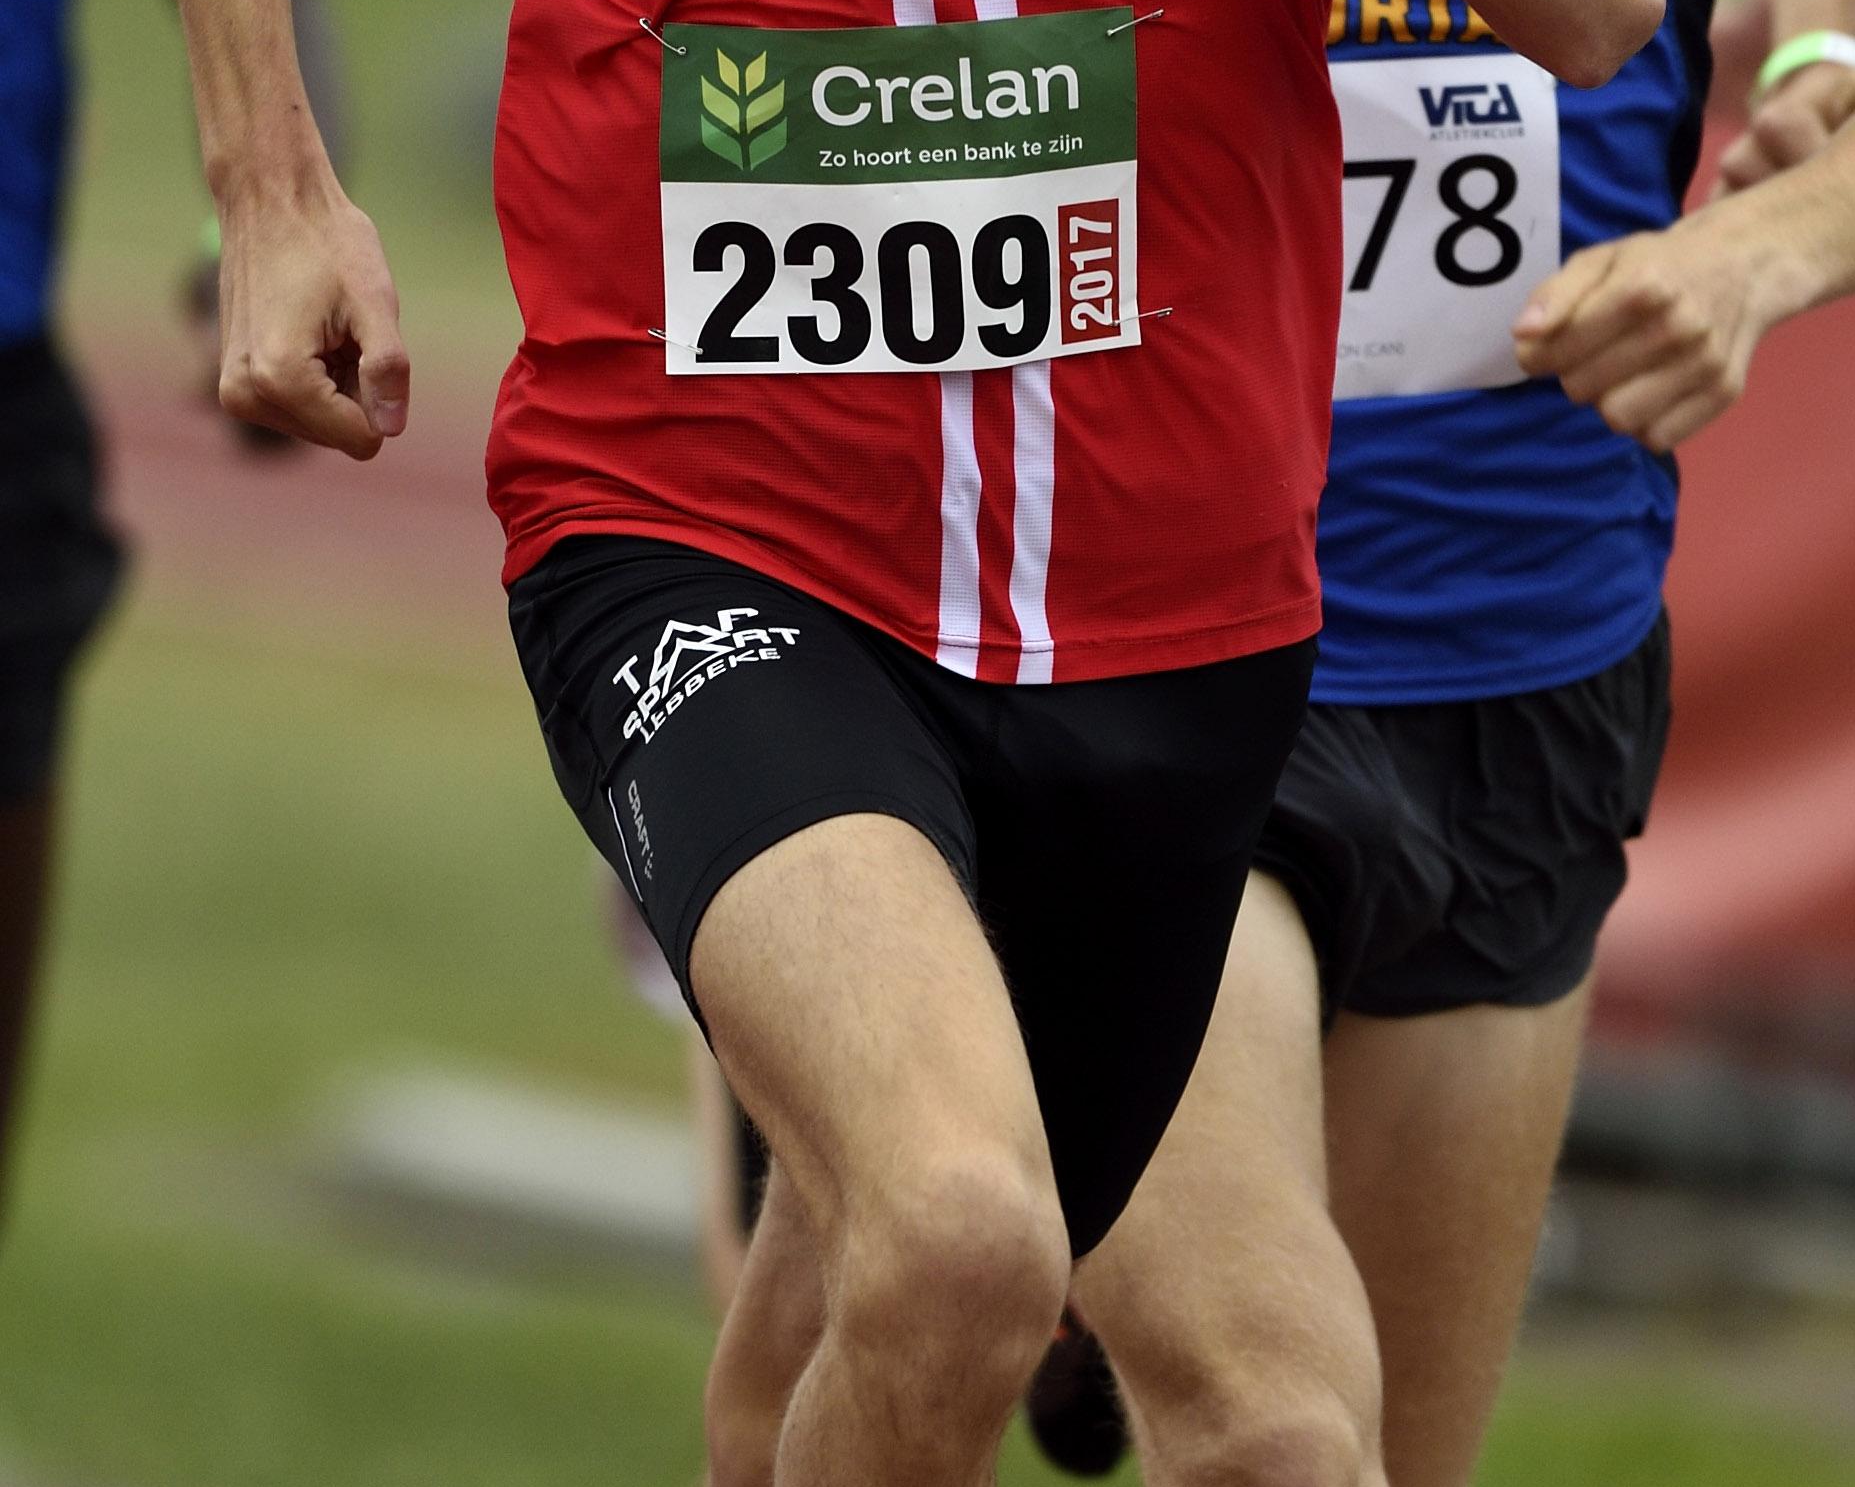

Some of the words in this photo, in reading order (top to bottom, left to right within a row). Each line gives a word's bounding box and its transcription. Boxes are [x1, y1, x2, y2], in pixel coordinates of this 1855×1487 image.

[811, 56, 1080, 127] Crelan
[819, 150, 846, 168] Zo
[853, 147, 912, 167] hoort
[918, 147, 958, 164] een
[964, 141, 1017, 162] bank
[1021, 140, 1042, 157] te
[1048, 134, 1084, 157] zijn
[692, 213, 1052, 367] 2309
[1069, 216, 1114, 333] 2017
[640, 647, 782, 745] LEBBEKE
